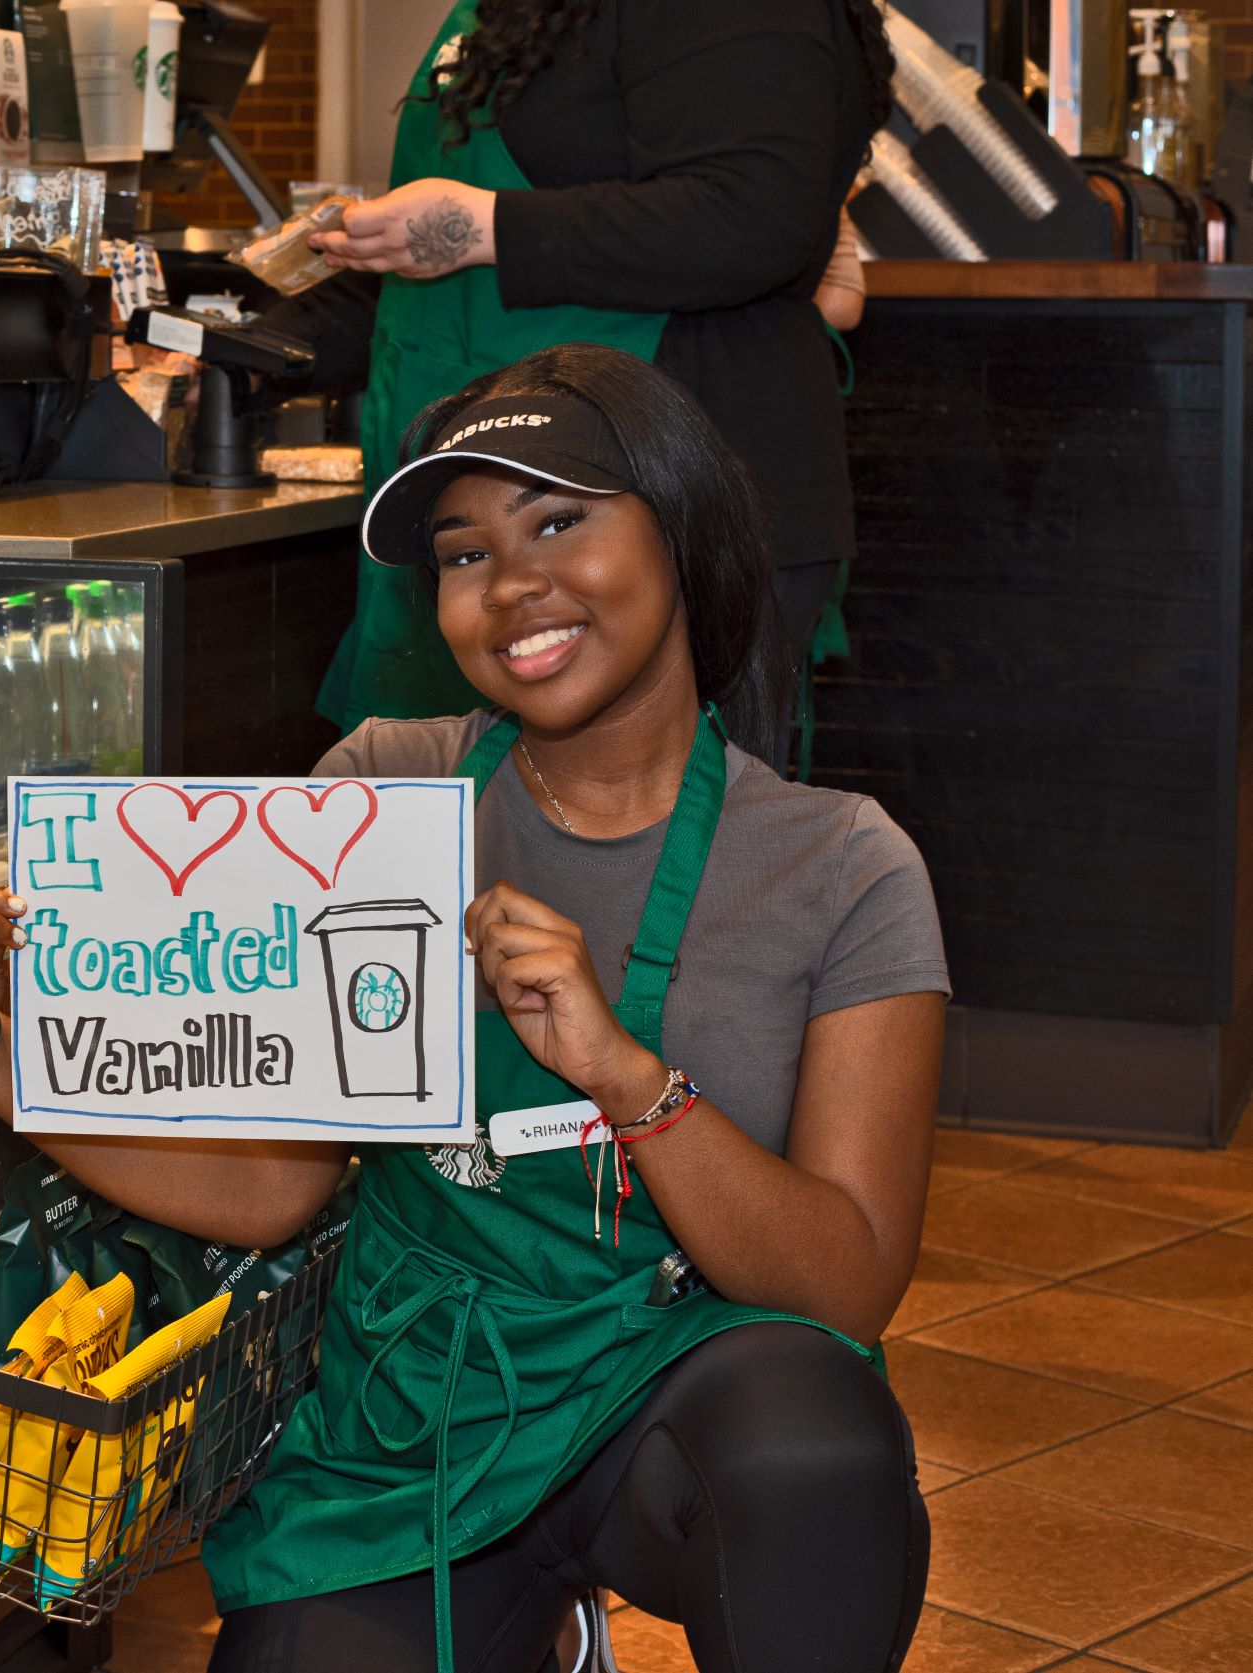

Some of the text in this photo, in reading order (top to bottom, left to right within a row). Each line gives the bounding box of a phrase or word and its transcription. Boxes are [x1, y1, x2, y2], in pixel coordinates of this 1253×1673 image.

[22, 792, 102, 892] I
[26, 903, 299, 996] toasted
[38, 1013, 294, 1096] Vanilla
[45, 1195, 78, 1223] BUTTER
[53, 1215, 74, 1231] FLAVORED
[229, 1248, 262, 1284] POPCORN
[73, 1338, 89, 1354] anic
